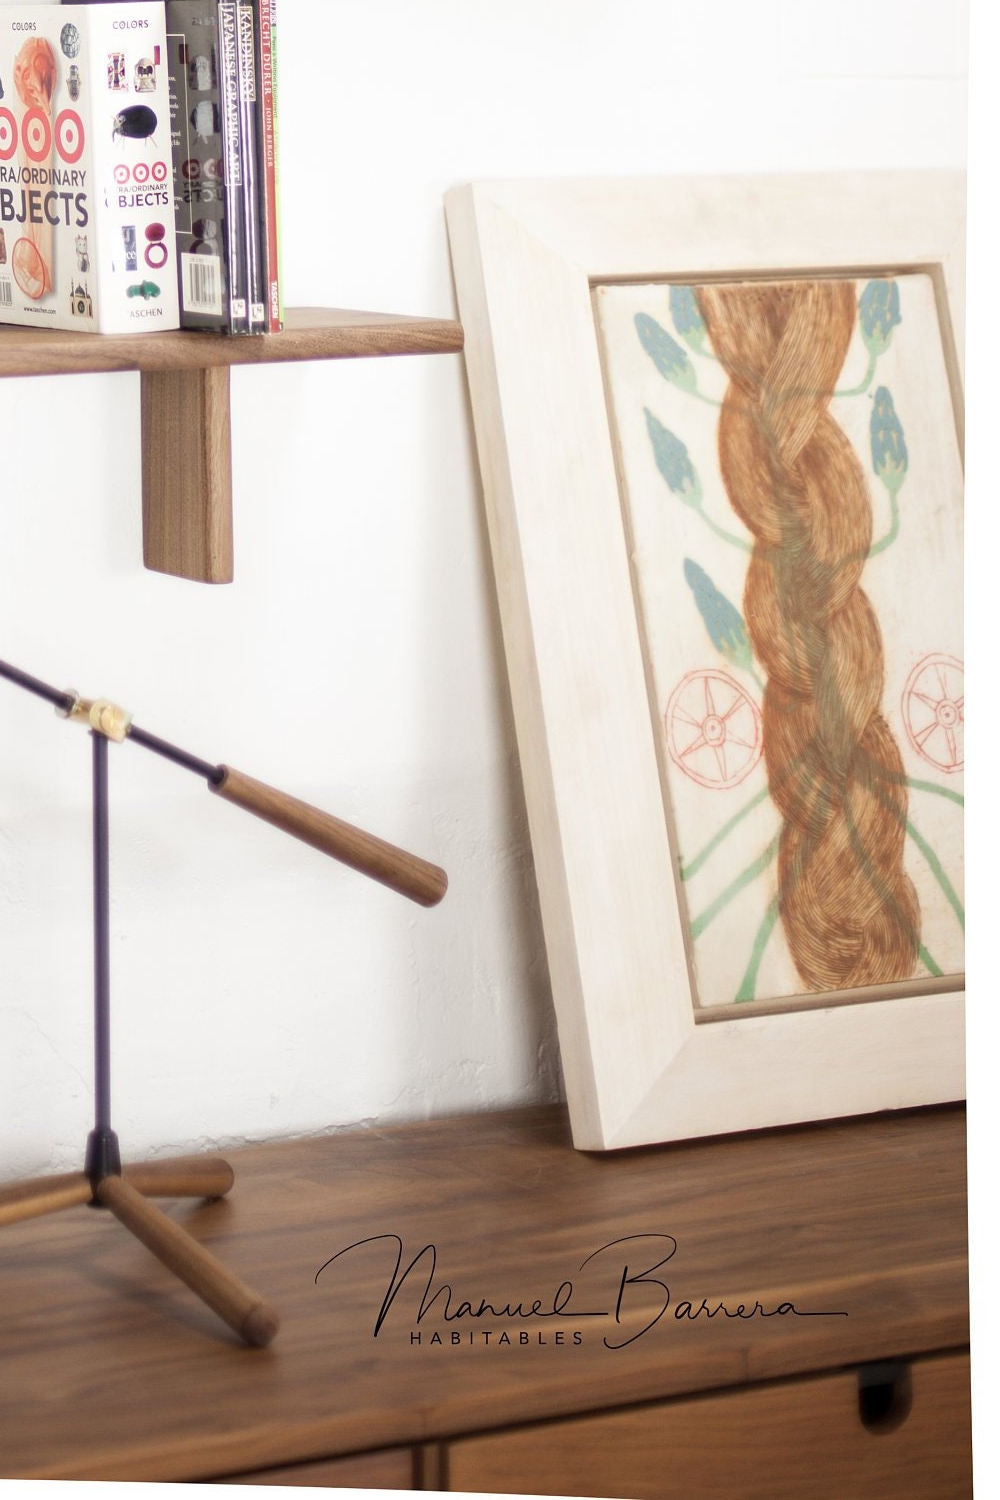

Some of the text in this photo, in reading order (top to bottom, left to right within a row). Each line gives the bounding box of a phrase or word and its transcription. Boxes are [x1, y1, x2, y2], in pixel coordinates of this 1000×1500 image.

[11, 22, 37, 31] COLORS
[112, 20, 150, 30] COLORS
[221, 7, 237, 77] JAPANESE
[240, 10, 255, 97] KANDINSKY
[265, 107, 273, 132] JOHN
[266, 133, 274, 168] BERGER
[105, 191, 169, 208] BJECTS
[23, 305, 56, 315] www.taschen.com
[271, 280, 279, 319] TASCHEN
[130, 308, 163, 318] ASCHEN
